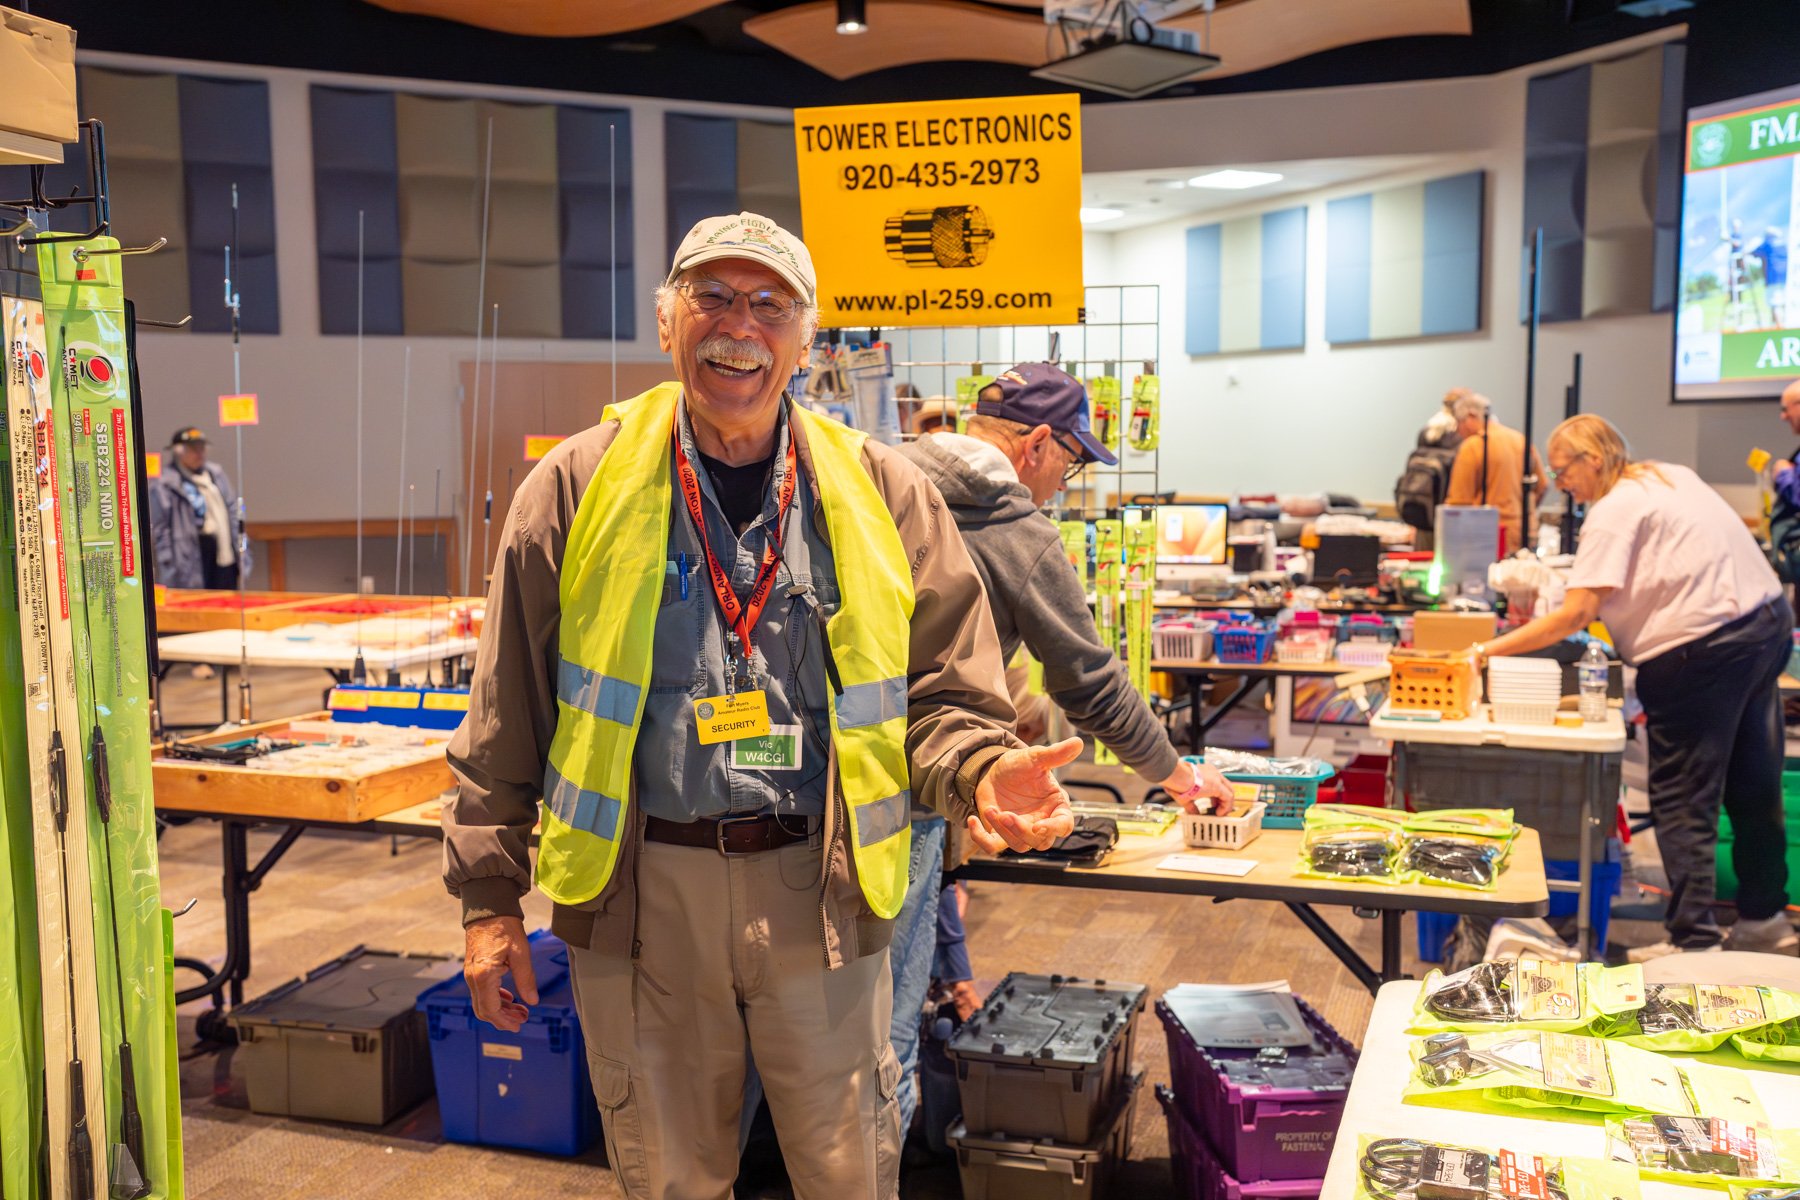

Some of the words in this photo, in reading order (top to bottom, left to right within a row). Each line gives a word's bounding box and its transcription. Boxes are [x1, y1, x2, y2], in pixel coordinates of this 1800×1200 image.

[802, 122, 888, 152] TOWER
[896, 112, 1072, 148] ELECTRONICS
[1748, 111, 1800, 150] FM
[843, 157, 1040, 190] 920-435-2973
[834, 288, 1052, 315] www.pl-259.com
[96, 423, 111, 487] SBB224
[682, 467, 695, 490] 2020
[100, 492, 114, 530] NMO
[711, 719, 757, 733] SECURITY
[758, 740, 773, 749] Vic
[745, 752, 785, 763] W4CGI
[1275, 1132, 1321, 1141] PROPERTY
[1322, 1131, 1333, 1141] OF
[1281, 1142, 1326, 1152] FASTENAL
